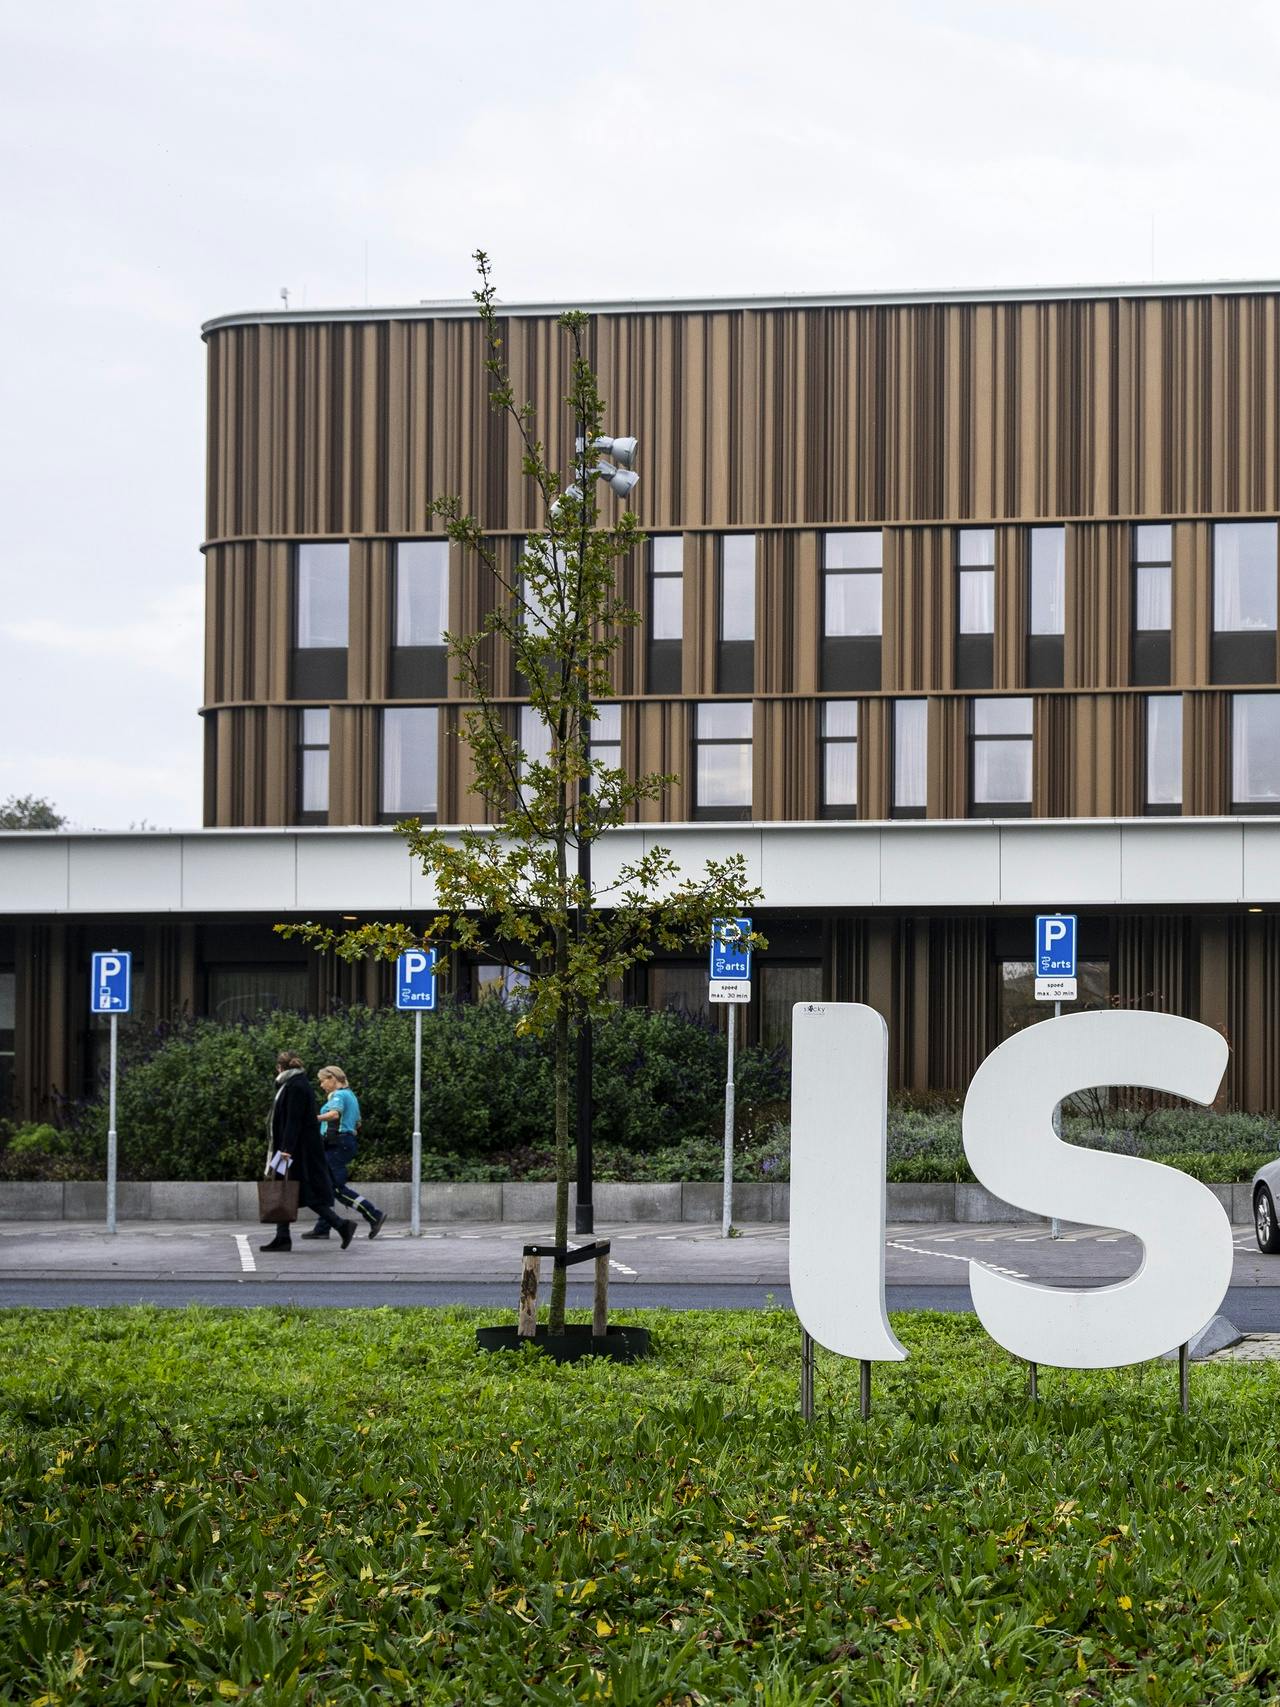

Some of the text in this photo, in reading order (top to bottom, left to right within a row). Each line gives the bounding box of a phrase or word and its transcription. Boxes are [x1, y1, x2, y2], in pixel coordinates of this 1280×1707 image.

[720, 922, 742, 953] P
[1045, 920, 1067, 951] P
[100, 957, 121, 987] P
[405, 953, 427, 984] P
[725, 962, 745, 971] arts
[1050, 960, 1071, 969] arts
[410, 992, 431, 1001] arts
